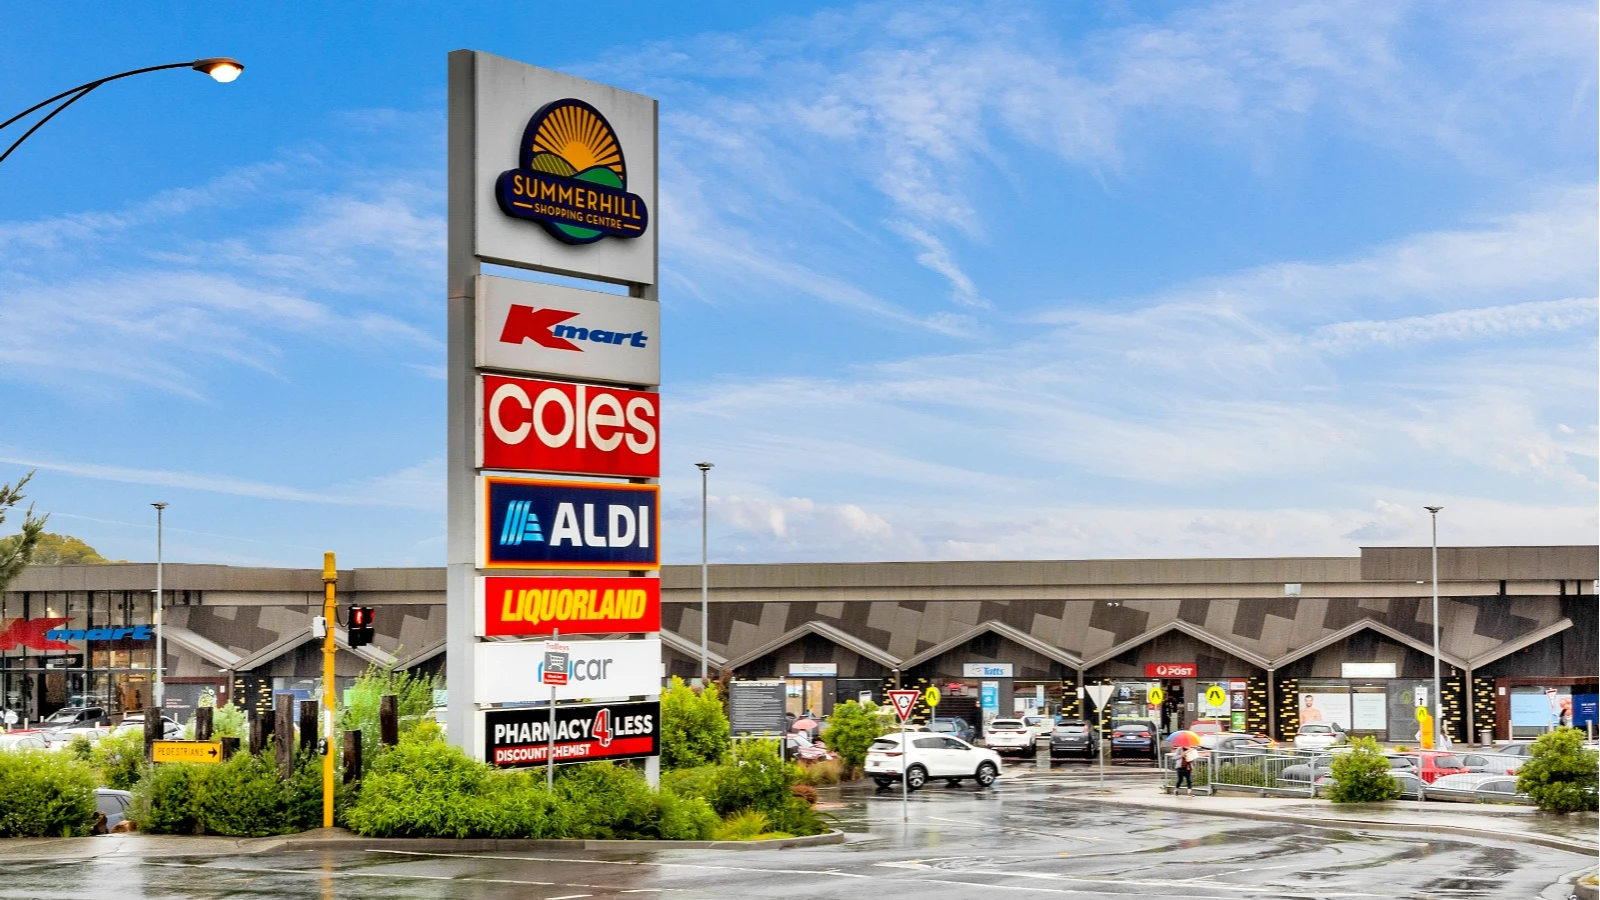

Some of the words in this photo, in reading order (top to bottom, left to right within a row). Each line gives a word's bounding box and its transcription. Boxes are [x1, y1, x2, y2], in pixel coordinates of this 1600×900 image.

[512, 174, 641, 220] SUMMERHILL
[534, 202, 584, 223] SHOPPING
[585, 213, 623, 230] CENTRE
[499, 303, 649, 353] Kmart
[488, 384, 656, 455] coles
[549, 502, 650, 548] ALDI
[500, 588, 648, 626] LIQUORLAND
[0, 617, 154, 651] Kmart
[537, 657, 613, 683] car
[983, 667, 1005, 676] Tatts
[1168, 668, 1193, 676] POST
[494, 718, 592, 744] PHARMACY
[591, 708, 614, 748] 4
[614, 714, 653, 736] LESS
[157, 747, 205, 757] PEDESTRIANS
[496, 746, 548, 762] DISCOUNT
